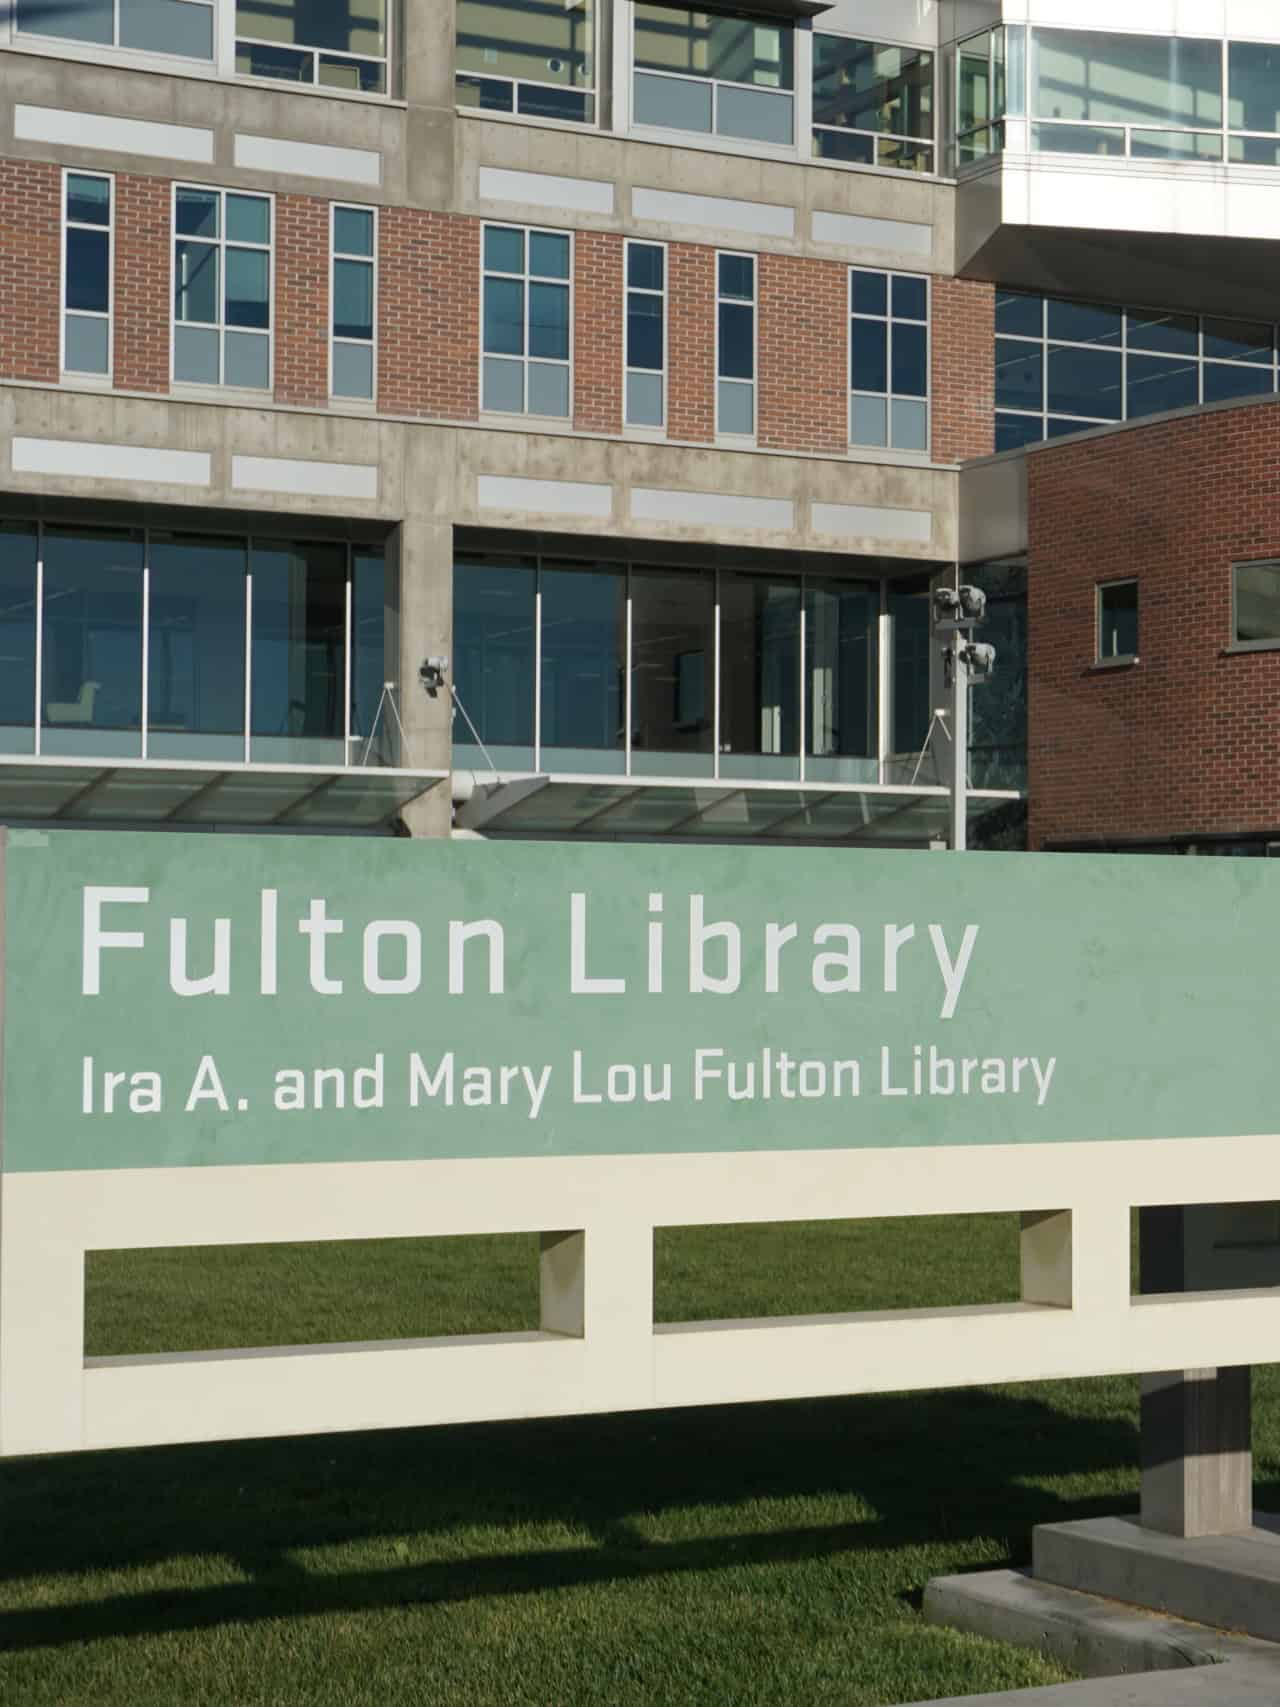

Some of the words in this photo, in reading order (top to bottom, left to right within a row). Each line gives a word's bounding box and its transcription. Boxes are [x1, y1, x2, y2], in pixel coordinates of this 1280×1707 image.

[81, 885, 505, 997] Fulton
[570, 892, 980, 1019] Library
[82, 1056, 162, 1114] Ira
[184, 1055, 249, 1112] A.
[274, 1053, 385, 1111] and
[409, 1052, 553, 1119] Mary
[572, 1050, 672, 1104] Lou
[694, 1047, 860, 1101] Fulton
[880, 1045, 1057, 1106] Library
